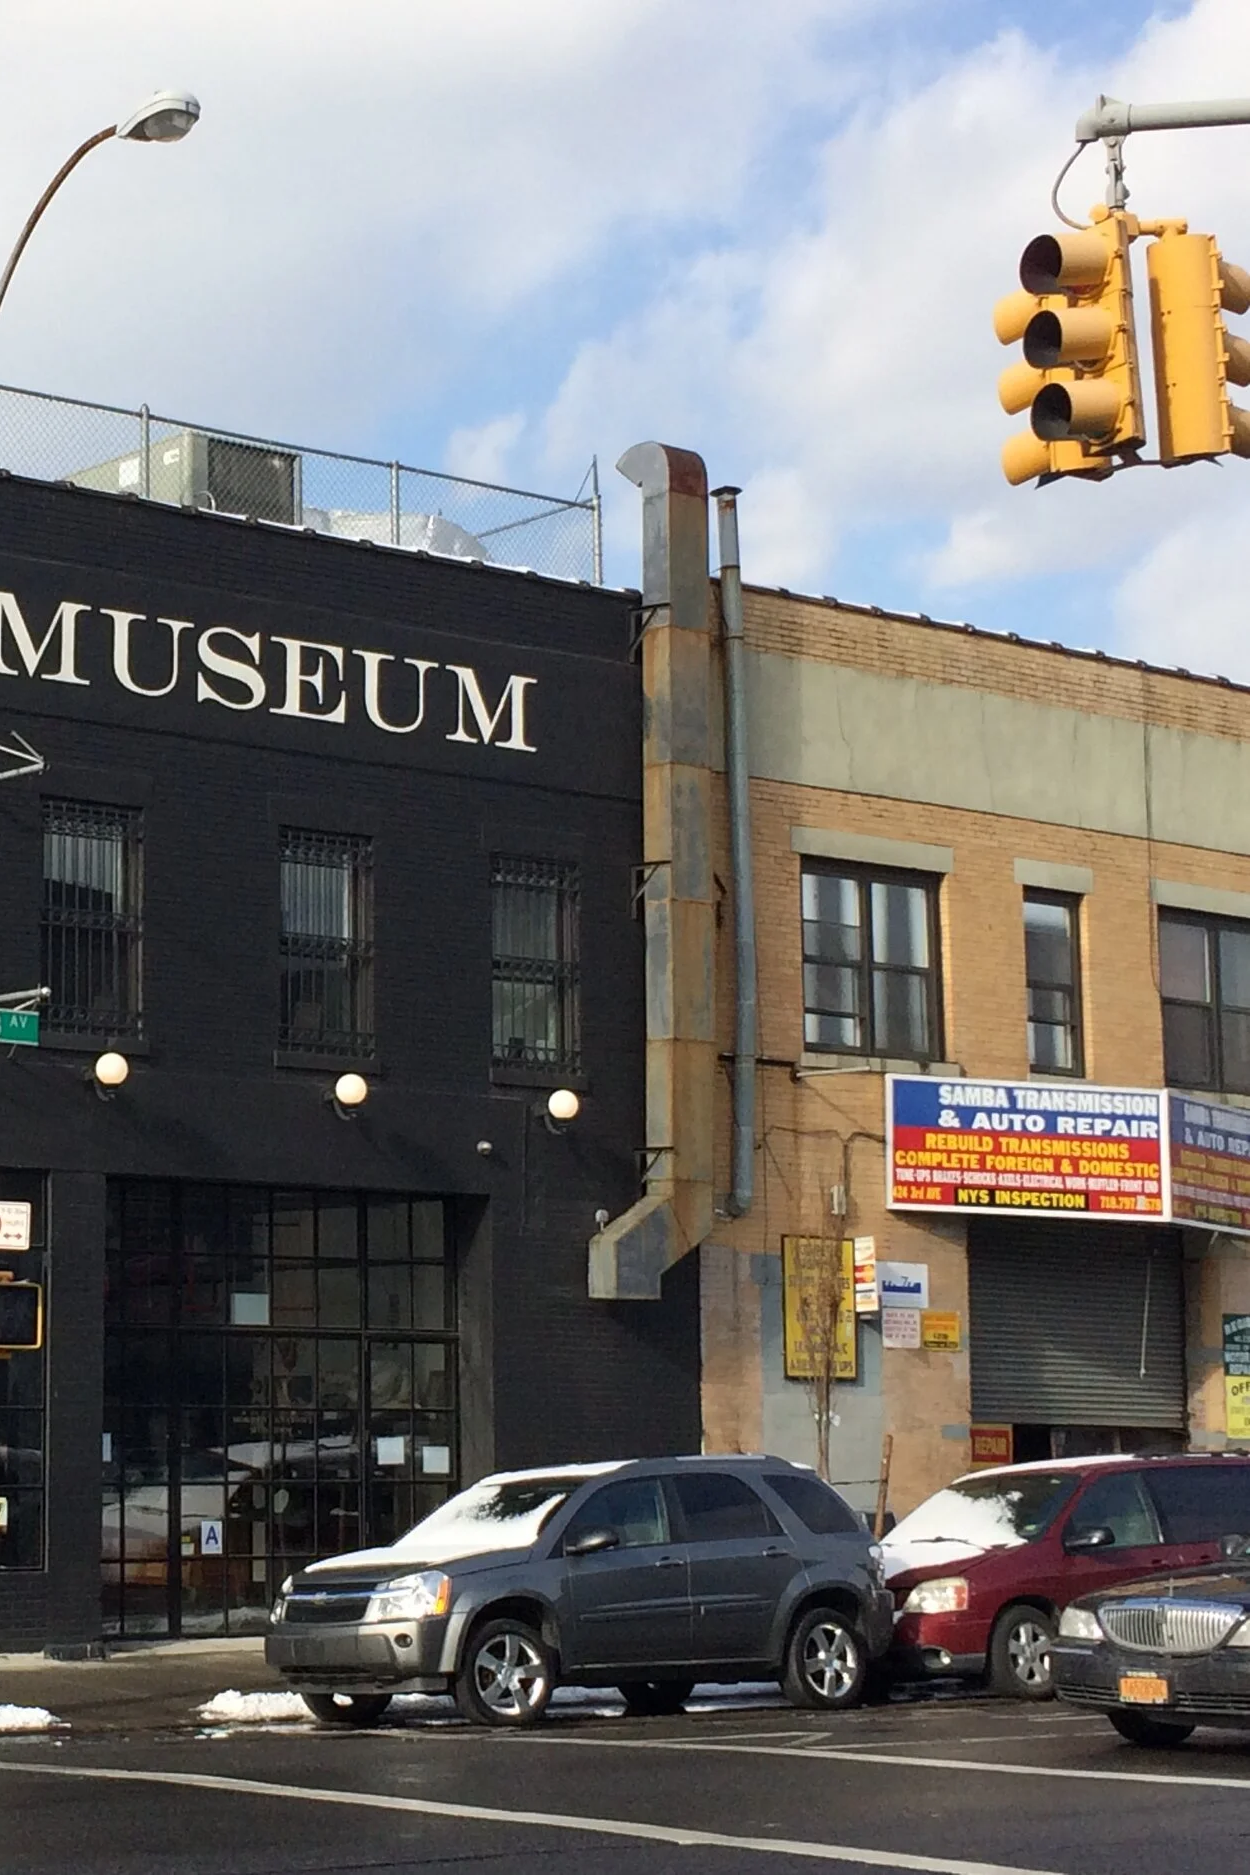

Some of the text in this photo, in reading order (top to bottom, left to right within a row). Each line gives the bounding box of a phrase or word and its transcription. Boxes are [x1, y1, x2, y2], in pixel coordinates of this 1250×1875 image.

[9, 1015, 28, 1028] AV
[938, 1084, 1010, 1109] SAMBA
[1013, 1089, 1158, 1116] TRANSMISSION
[938, 1109, 1159, 1138] & AUTO REPAIR
[925, 1133, 1130, 1159] REBUILD TRANSMISSIONS
[1197, 1130, 1225, 1151] AUTO
[895, 1150, 980, 1169] COMPLETE
[985, 1155, 1054, 1172] FOREIGN
[1060, 1158, 1073, 1174] &
[1079, 1160, 1160, 1178] DOMESTIC
[957, 1188, 1086, 1209] NYS INSPECTION
[974, 1436, 1007, 1455] REPAIR
[205, 1525, 219, 1545] A
